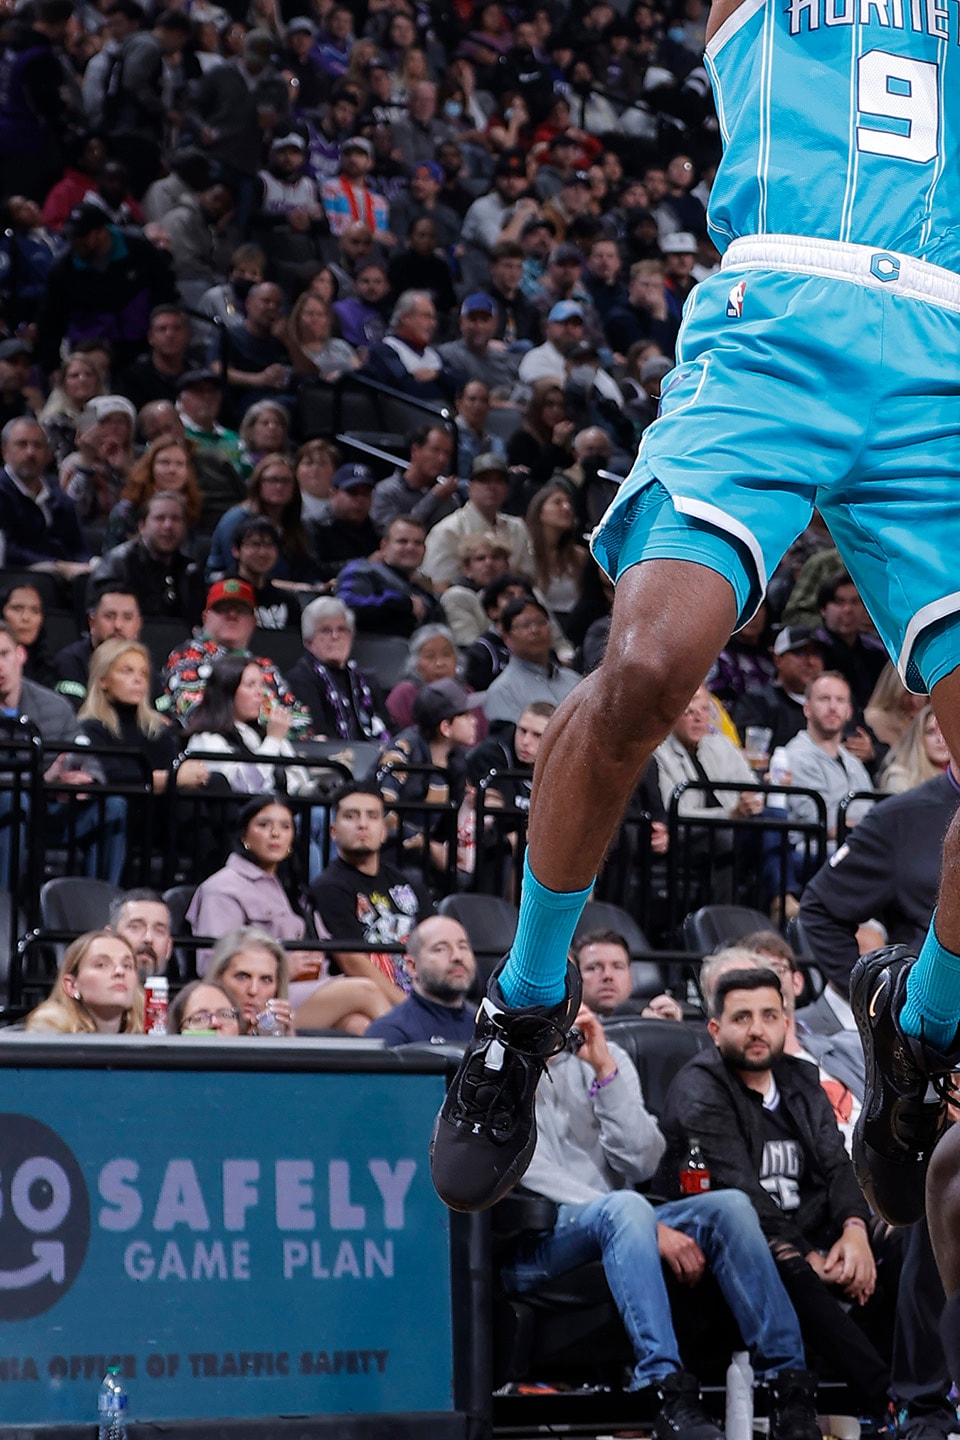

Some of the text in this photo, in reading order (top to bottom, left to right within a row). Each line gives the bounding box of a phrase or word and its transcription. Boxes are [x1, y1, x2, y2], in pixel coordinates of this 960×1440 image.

[856, 48, 940, 165] 9
[0, 1156, 71, 1233] O
[98, 1157, 418, 1232] SAFELY
[124, 1238, 395, 1281] GAME PLAN
[147, 1353, 180, 1378] OF
[187, 1351, 290, 1377] TRAFFIC
[298, 1349, 390, 1375] SAFETY
